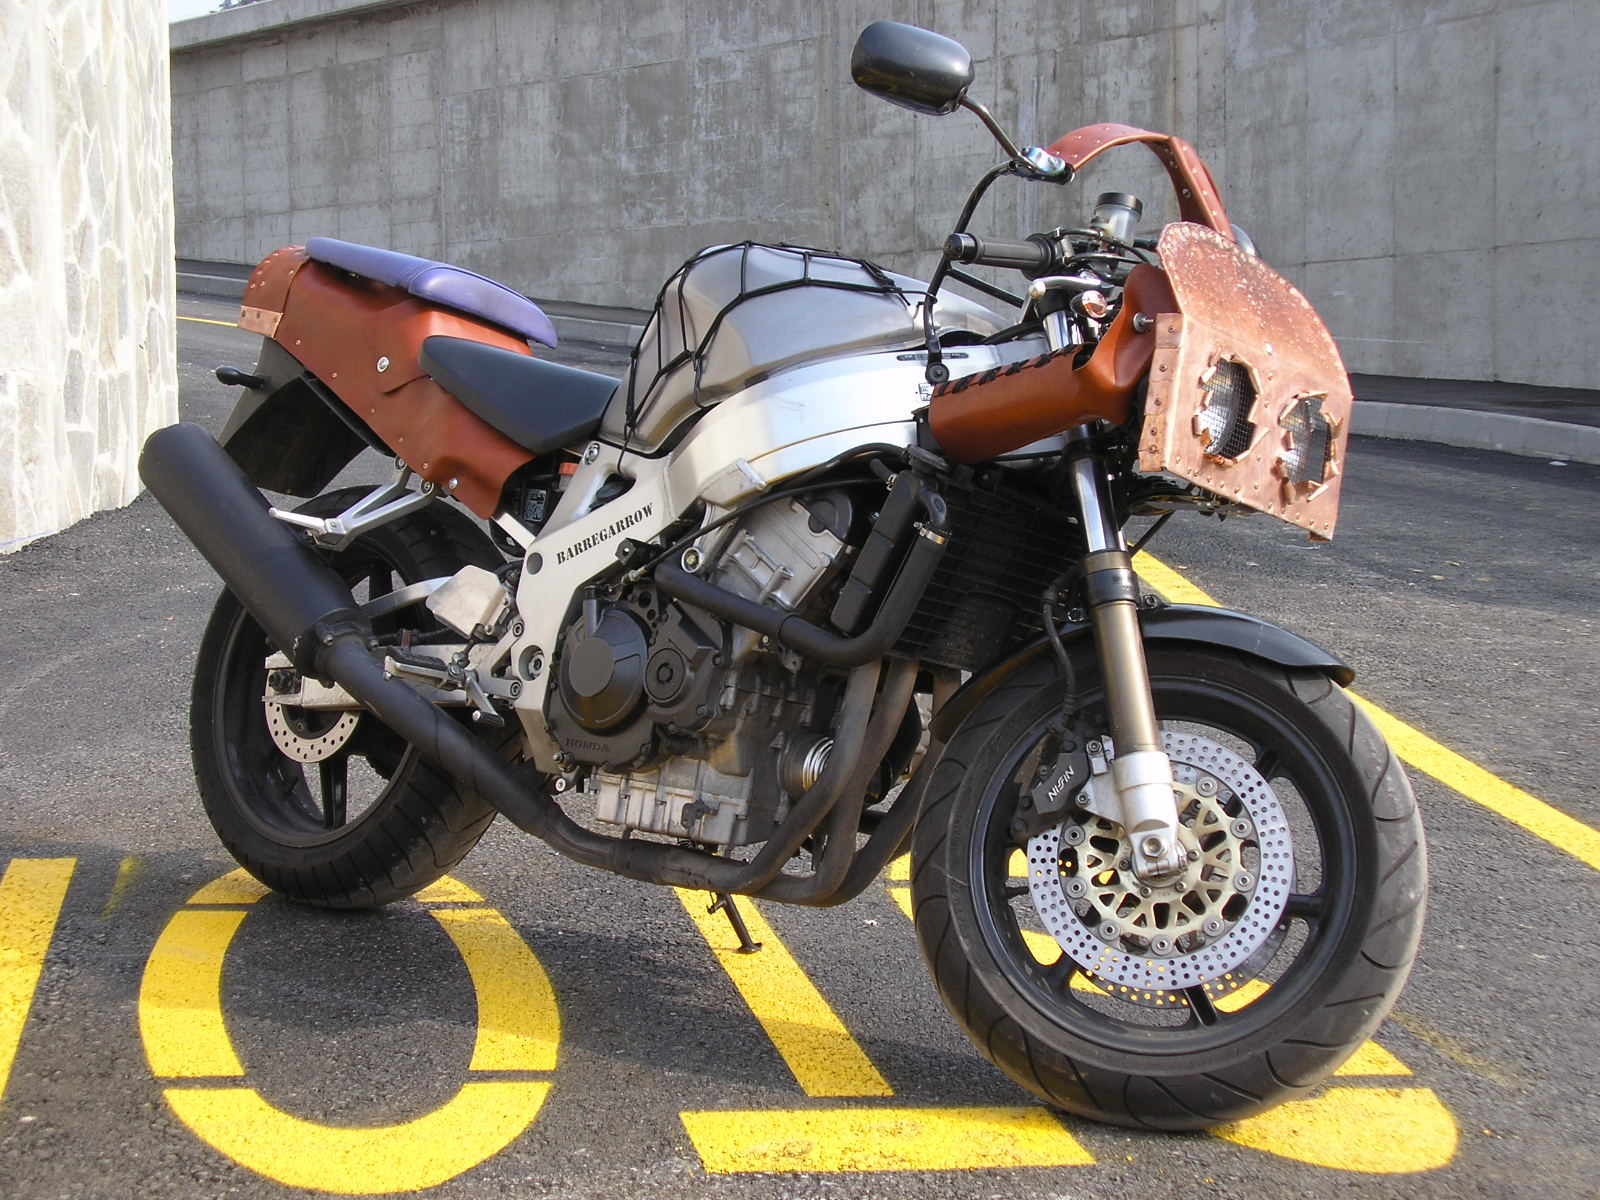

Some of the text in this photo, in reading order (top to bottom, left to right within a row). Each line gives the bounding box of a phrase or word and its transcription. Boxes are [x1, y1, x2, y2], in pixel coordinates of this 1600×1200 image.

[556, 502, 653, 565] BARREGARROW
[565, 738, 610, 753] HONDA
[1047, 765, 1075, 802] NISSIN
